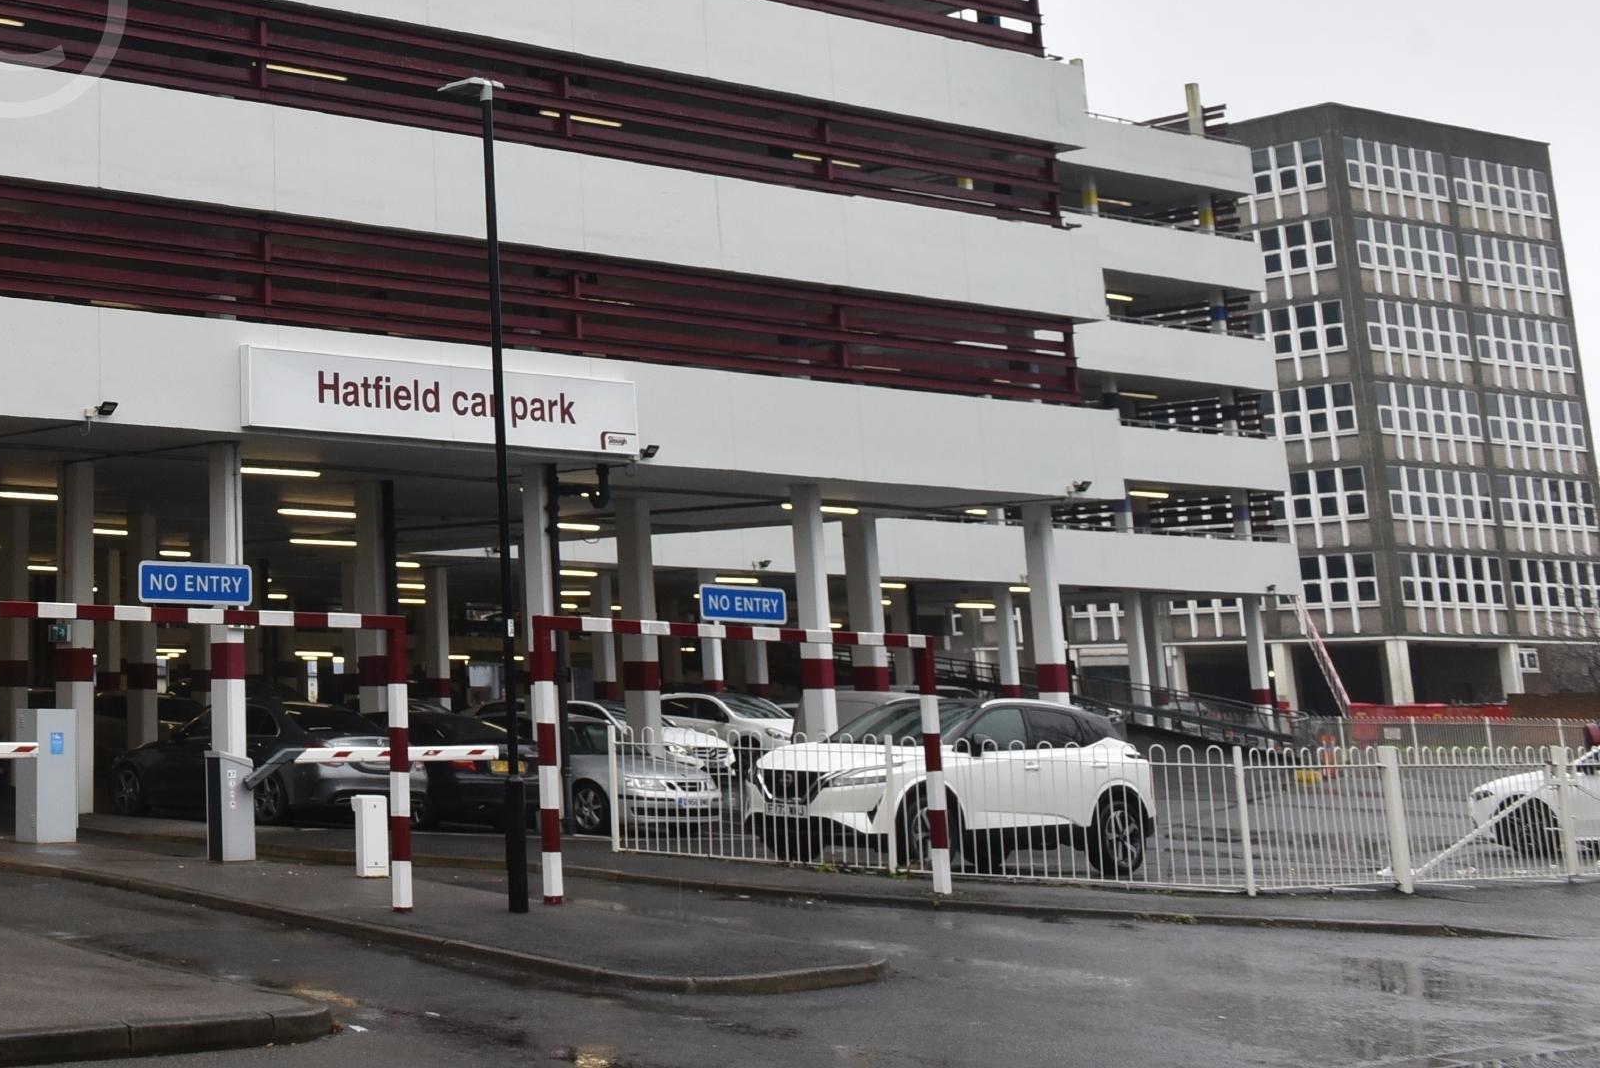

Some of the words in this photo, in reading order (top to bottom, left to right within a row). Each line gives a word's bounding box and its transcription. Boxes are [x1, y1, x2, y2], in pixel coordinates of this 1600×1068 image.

[317, 370, 441, 413] Hatfield
[510, 392, 576, 428] park
[150, 573, 178, 592] NO
[184, 574, 242, 593] ENTRY
[708, 594, 730, 611] NO
[734, 596, 778, 613] ENTRY
